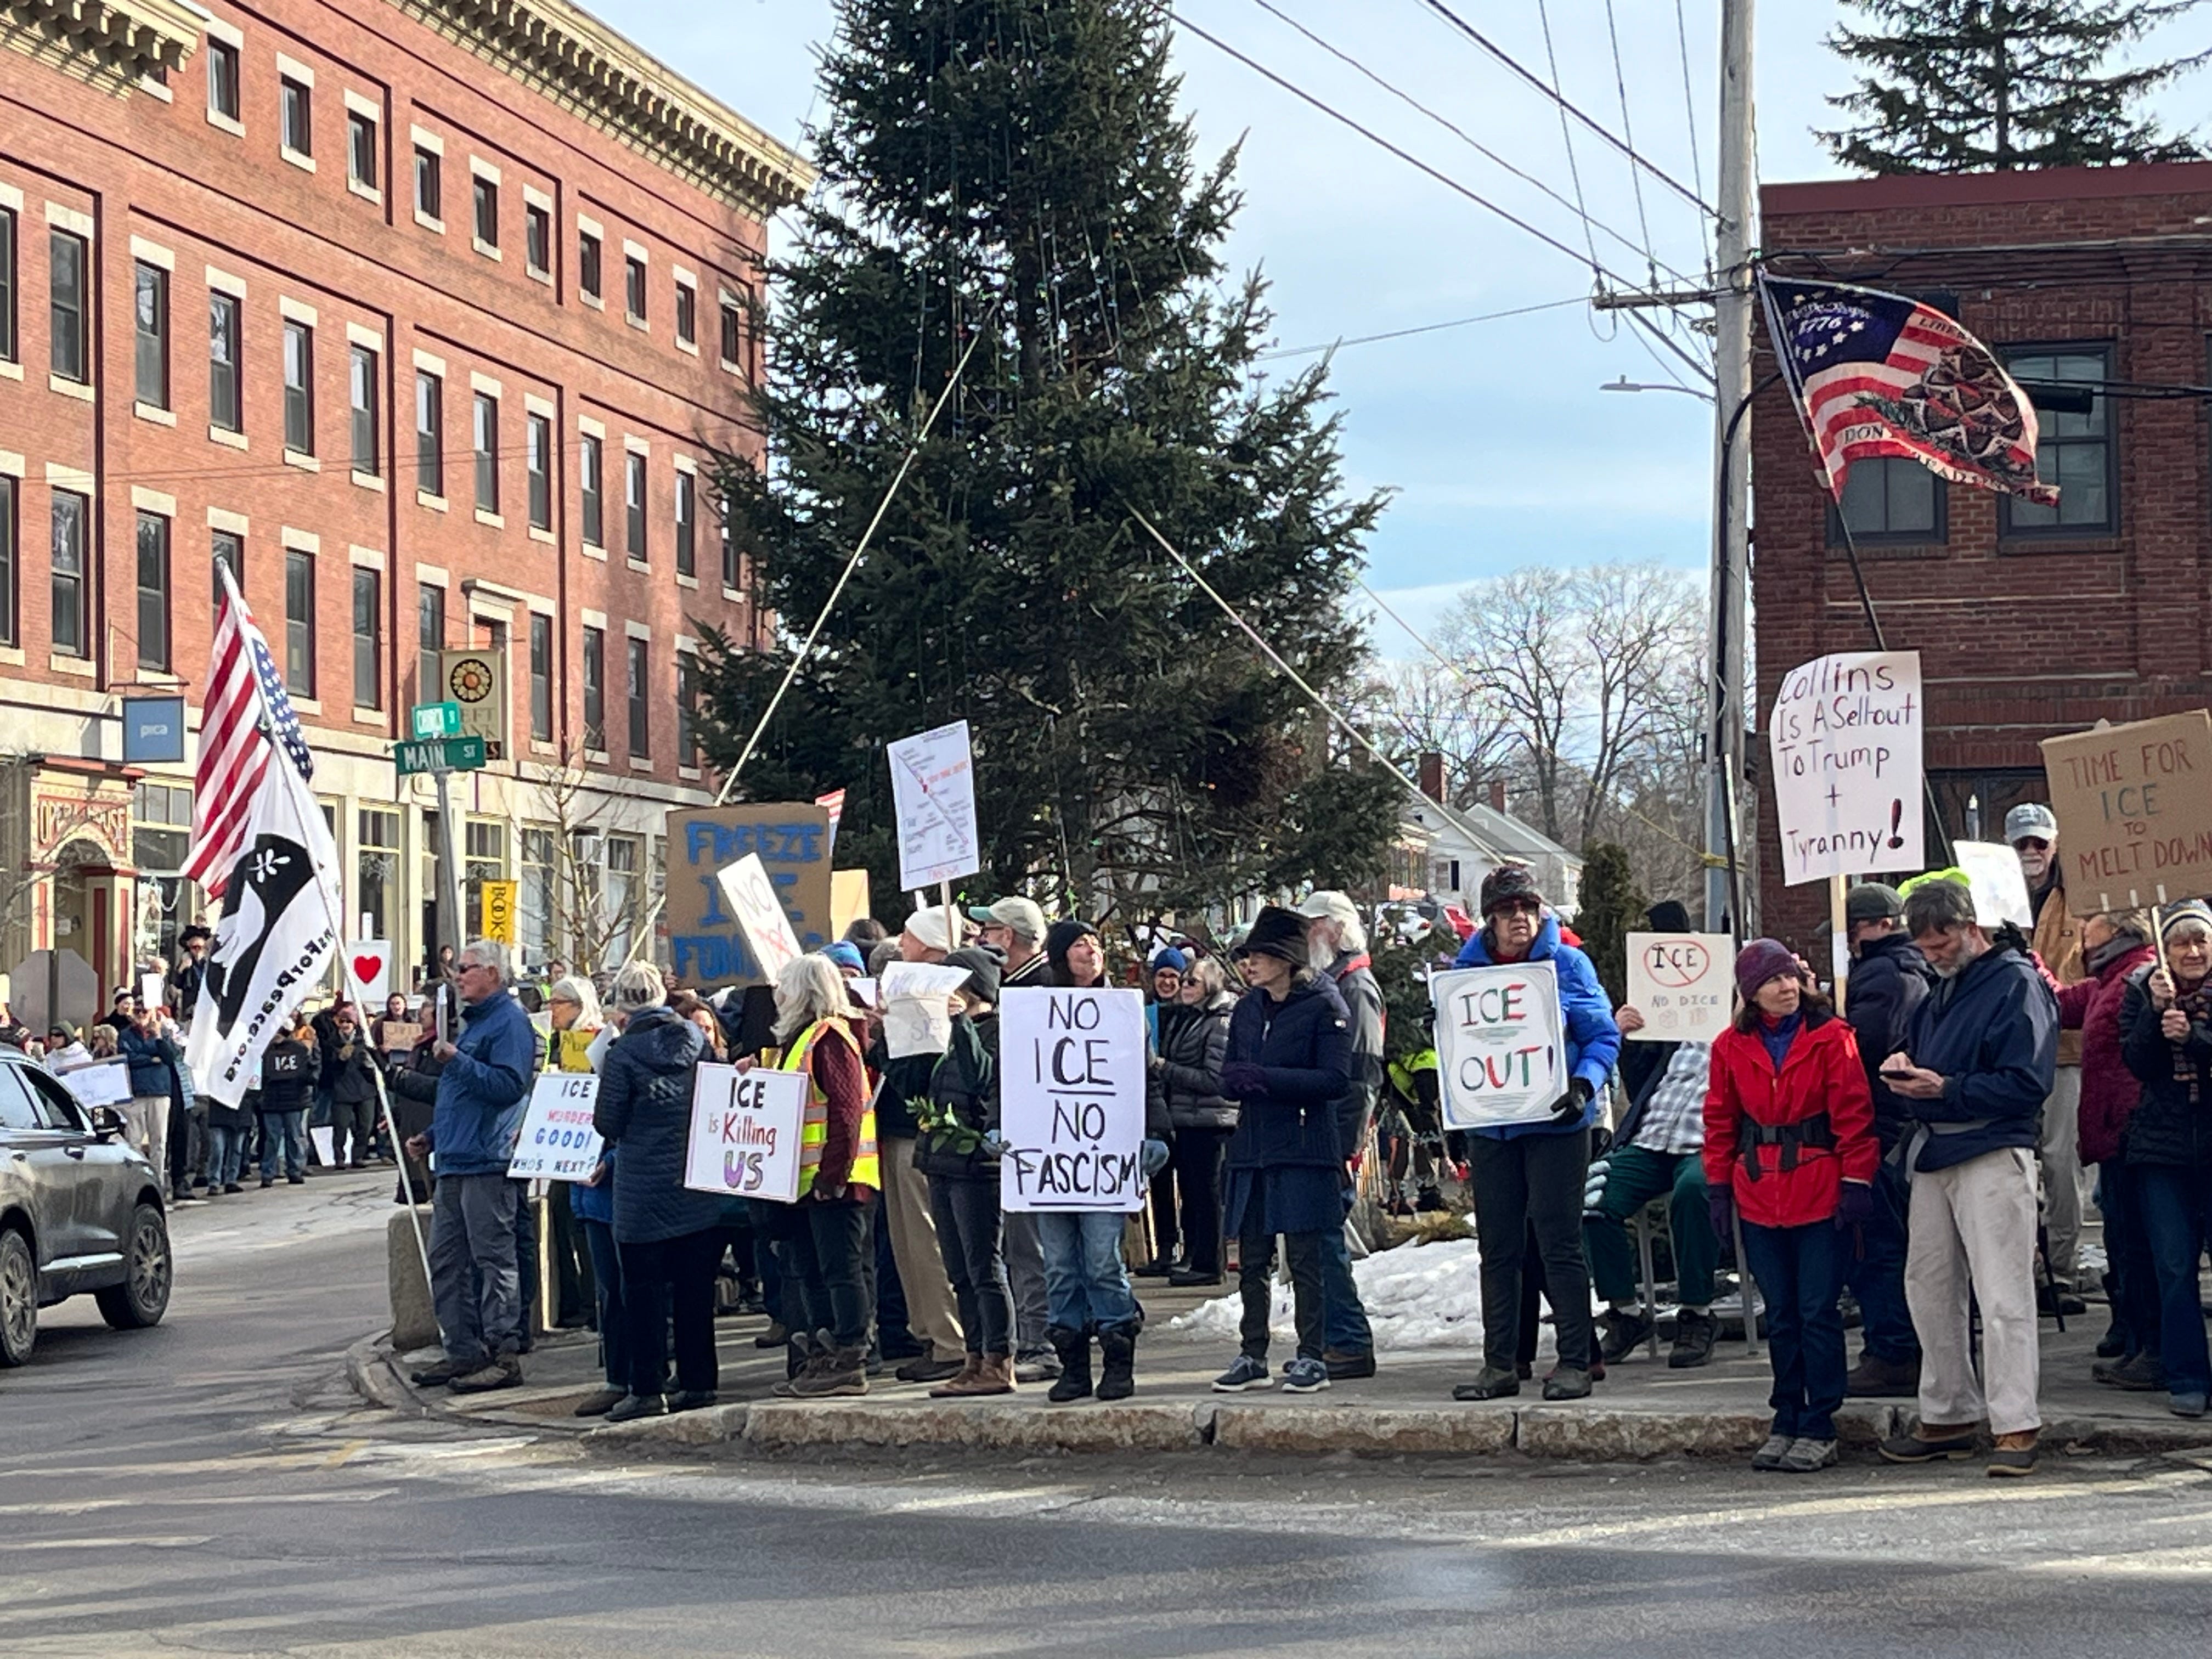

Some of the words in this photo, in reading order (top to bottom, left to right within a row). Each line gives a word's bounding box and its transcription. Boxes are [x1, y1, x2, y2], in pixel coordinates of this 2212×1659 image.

[1799, 315, 1842, 335] 1776
[1779, 657, 1894, 705] Collins
[1778, 708, 1801, 743] Is
[404, 744, 446, 770] MAIN
[464, 744, 476, 758] ST
[1779, 745, 1804, 777] To
[1807, 739, 1890, 778] Trump
[2062, 750, 2123, 789] TIME
[2142, 739, 2192, 775] FOR
[2101, 783, 2160, 821] ICE
[686, 821, 823, 865] FREEZE
[2124, 822, 2146, 836] TO
[2079, 842, 2142, 881] MELT
[2154, 831, 2212, 868] DOWN
[1652, 945, 1697, 969] ICE
[1048, 994, 1101, 1030] NO
[1459, 984, 1527, 1027] ICE
[1652, 995, 1669, 1008] NO
[1679, 995, 1718, 1006] DICE
[1035, 1036, 1114, 1086] ICE
[1460, 1045, 1554, 1091] OUT!
[561, 1080, 592, 1098] ICE
[729, 1077, 766, 1109] ICE
[723, 1112, 777, 1157] Killing
[1051, 1099, 1105, 1144] NO
[724, 1150, 764, 1191] US
